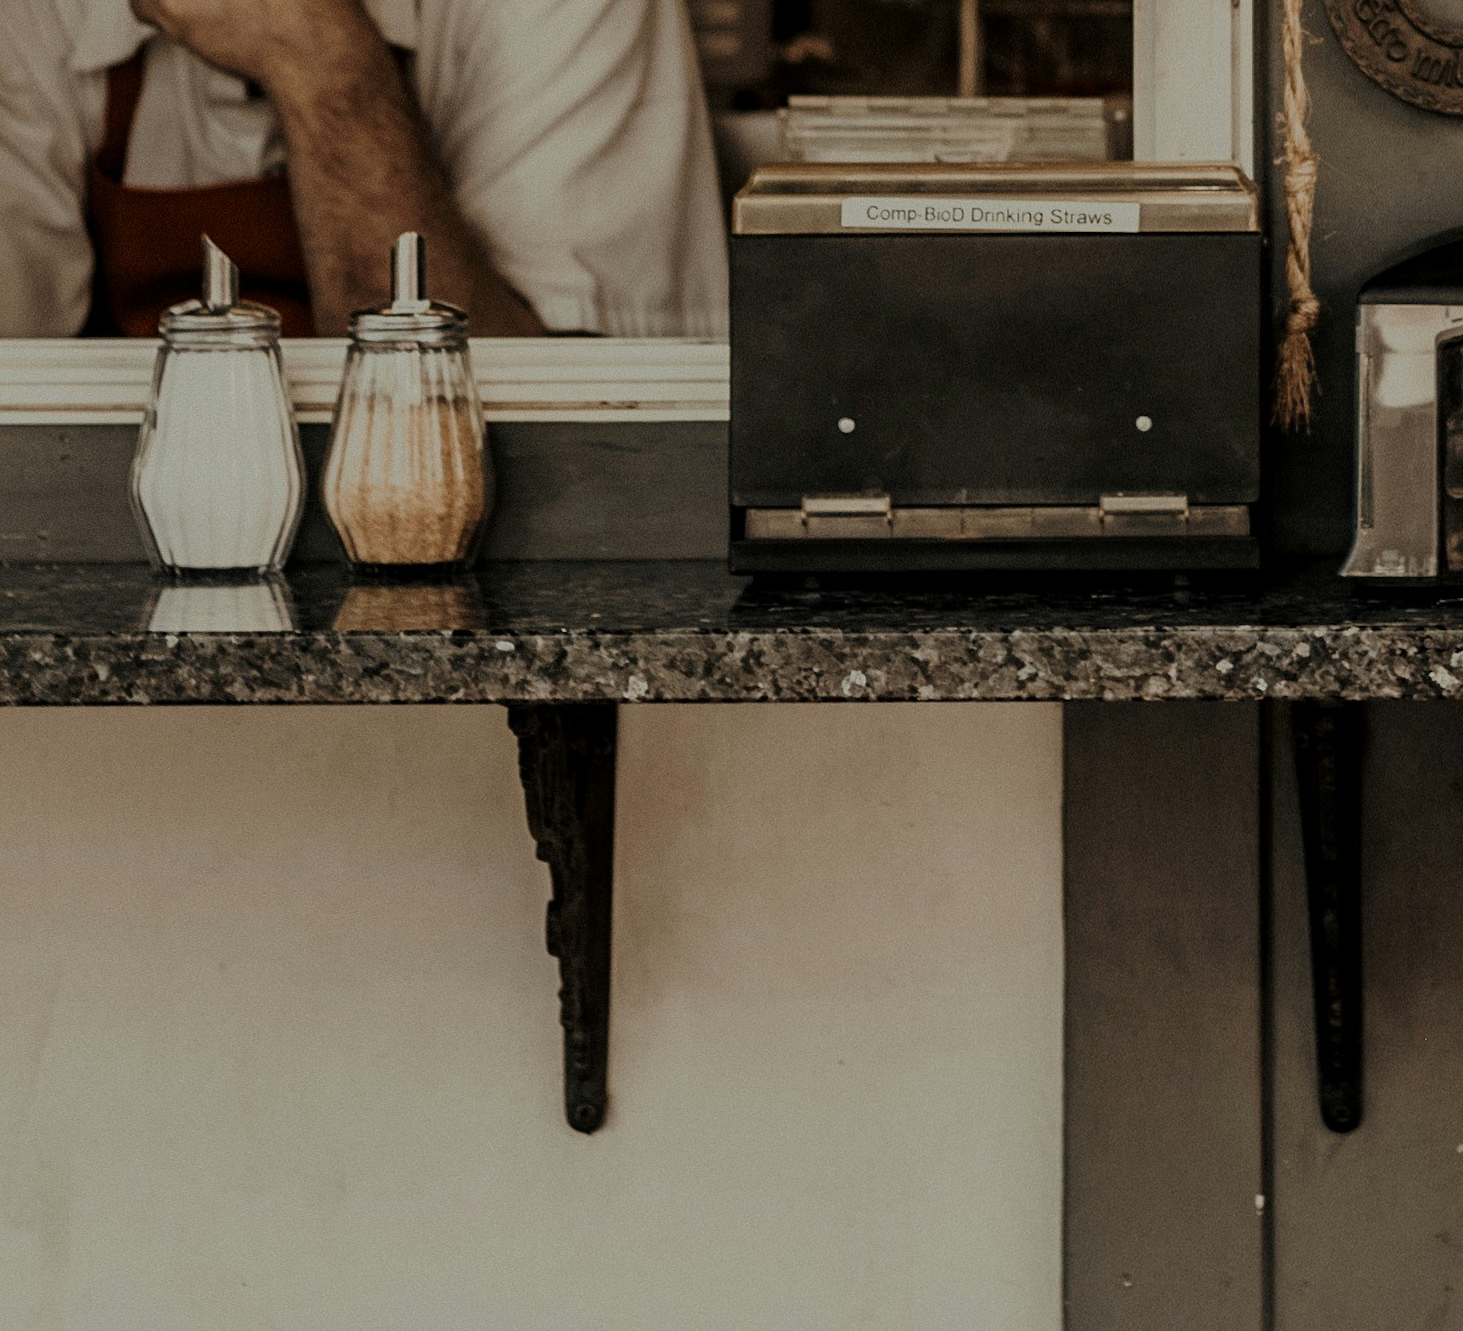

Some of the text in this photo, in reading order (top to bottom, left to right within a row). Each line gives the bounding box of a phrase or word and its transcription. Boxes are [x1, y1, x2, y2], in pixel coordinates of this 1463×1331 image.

[866, 204, 1113, 227] Comp-BioD Drinking Straws
